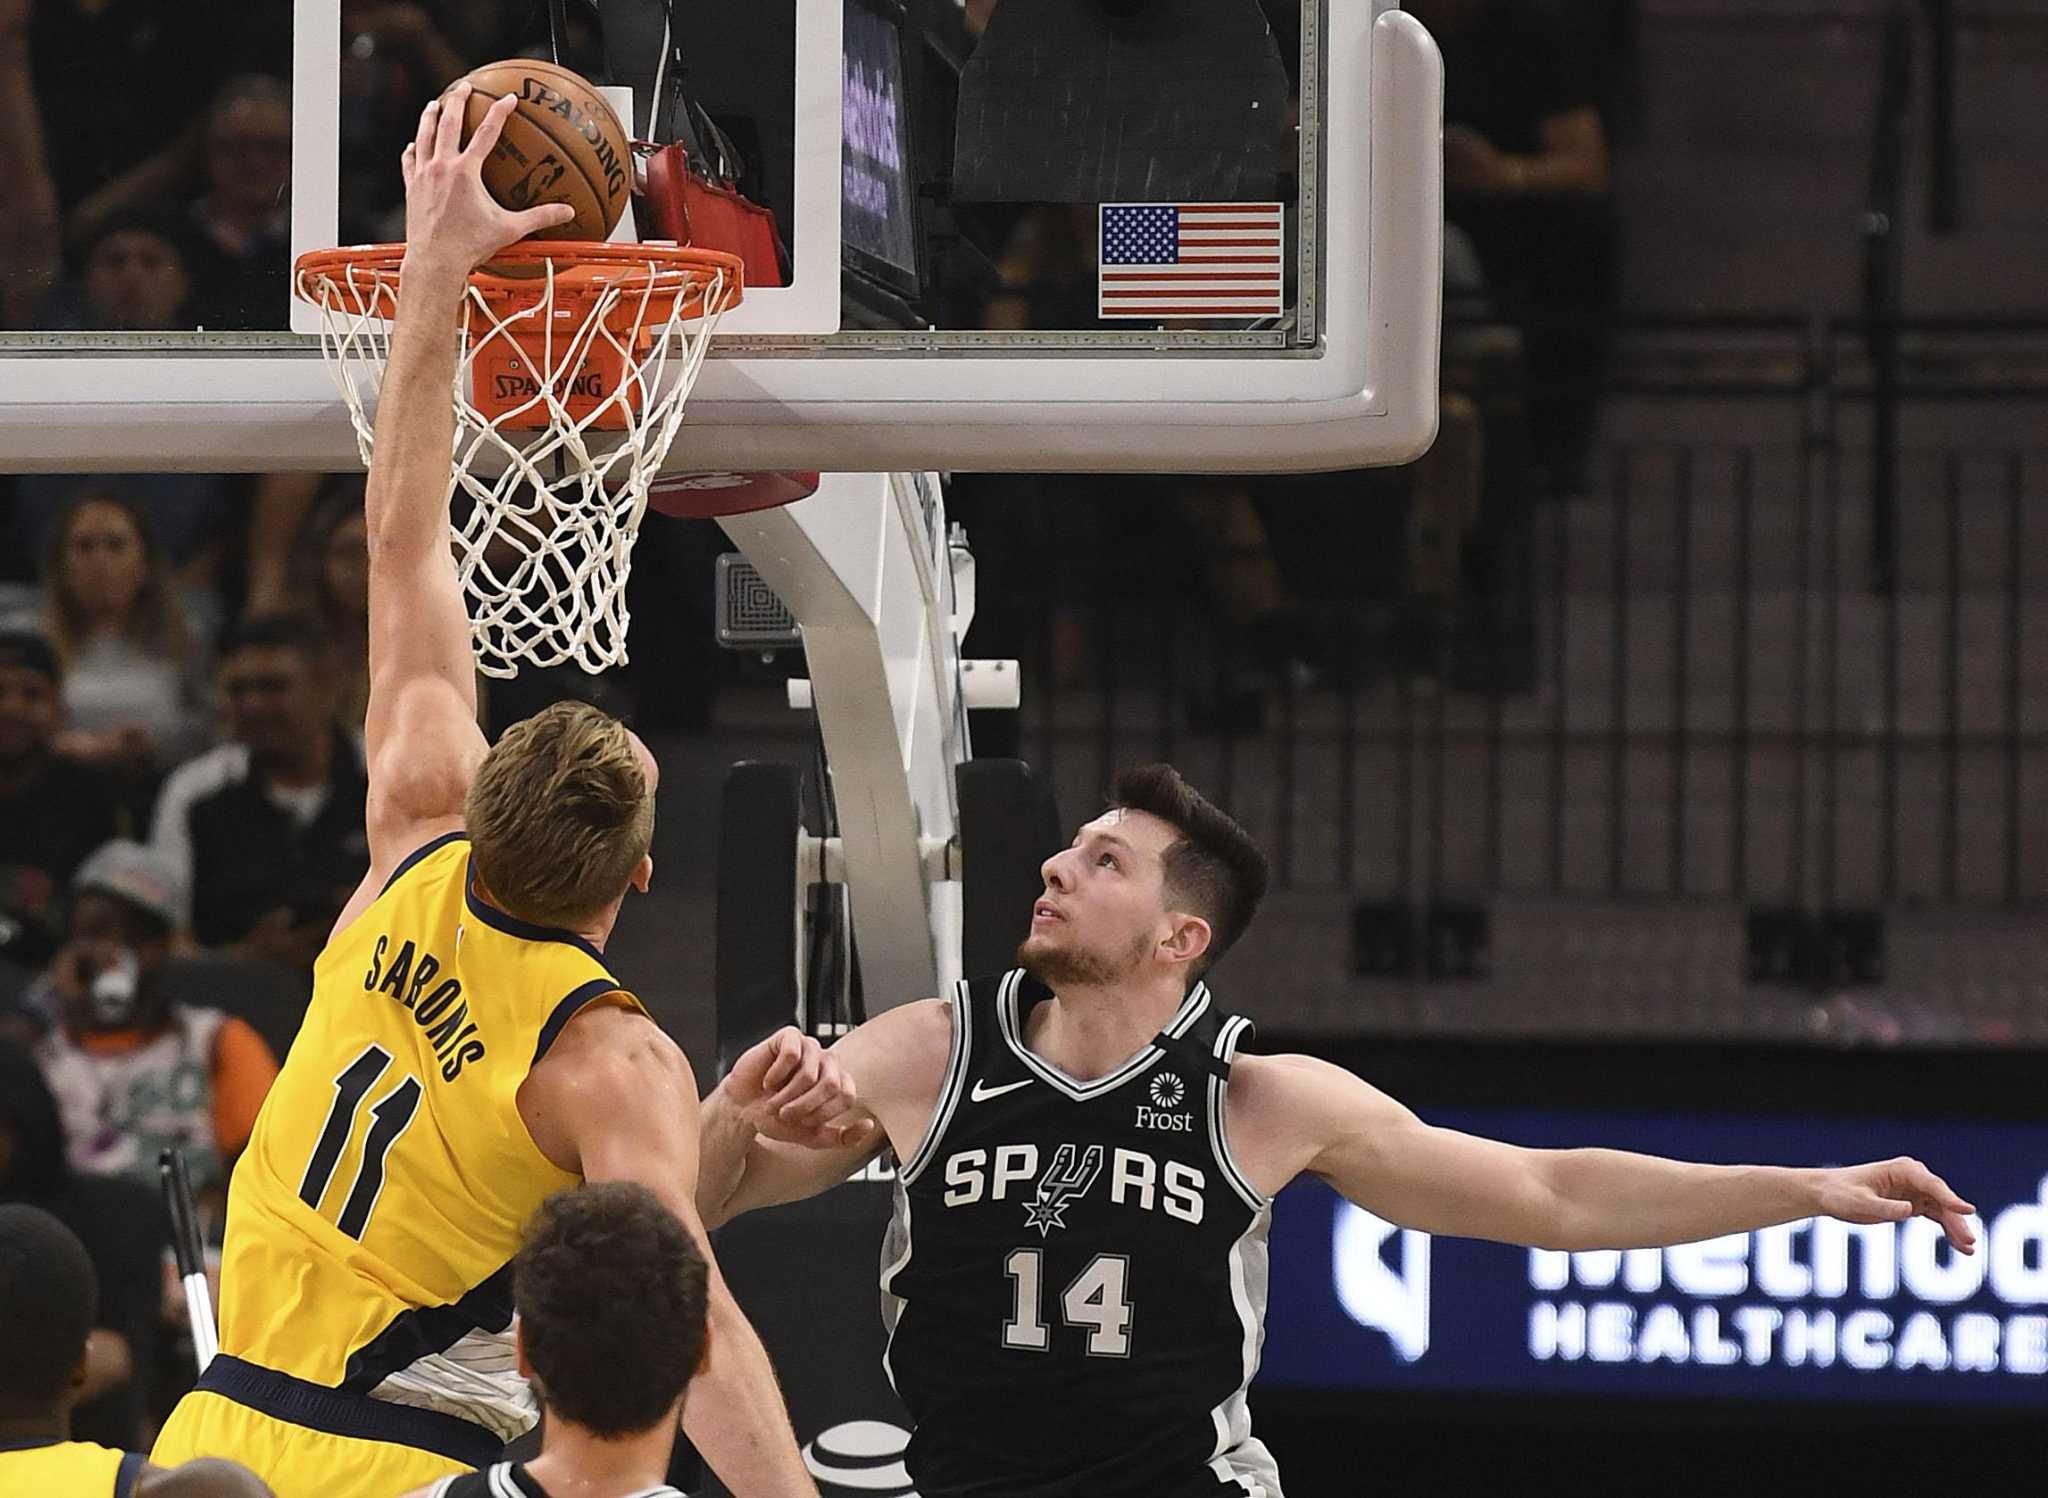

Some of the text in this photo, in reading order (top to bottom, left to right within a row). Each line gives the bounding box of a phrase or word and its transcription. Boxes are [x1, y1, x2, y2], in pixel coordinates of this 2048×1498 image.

[513, 77, 627, 198] SPALDING
[495, 374, 603, 399] SPADING
[364, 934, 486, 1083] SABONIS
[298, 1042, 424, 1243] 11
[1135, 1106, 1194, 1132] Frost
[944, 1143, 1206, 1239] SPURS
[1001, 1247, 1135, 1358] 14
[1528, 1301, 2048, 1374] HEALTHCARE
